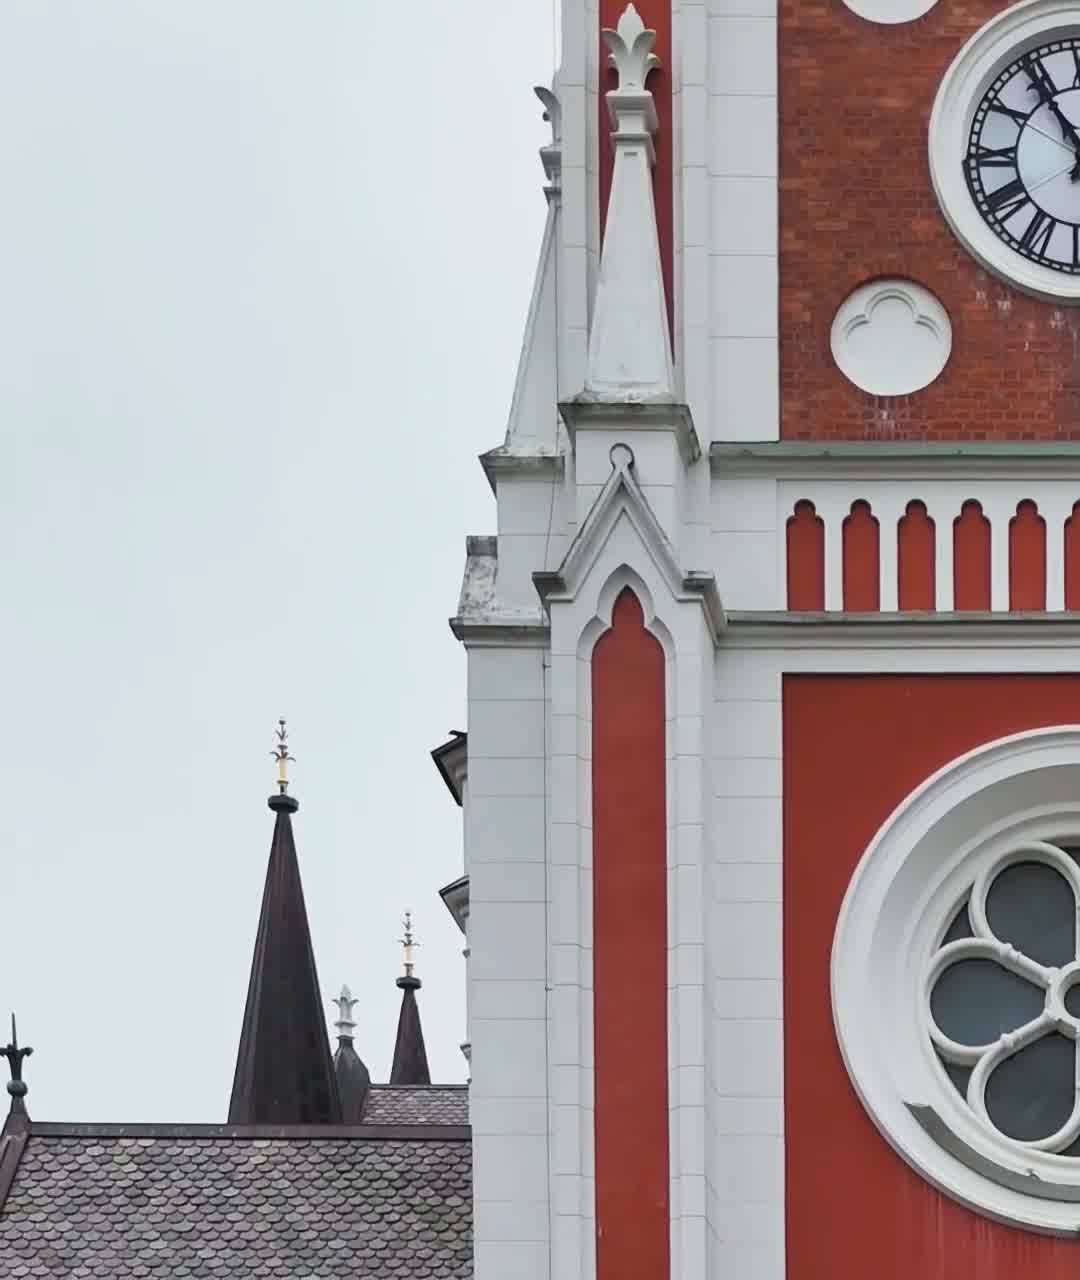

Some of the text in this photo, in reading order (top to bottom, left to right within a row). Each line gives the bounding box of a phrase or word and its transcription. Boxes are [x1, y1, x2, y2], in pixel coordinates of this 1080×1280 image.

[988, 95, 1031, 128] X
[977, 145, 1017, 167] IX
[984, 179, 1029, 224] VIII
[1020, 208, 1056, 257] VII
